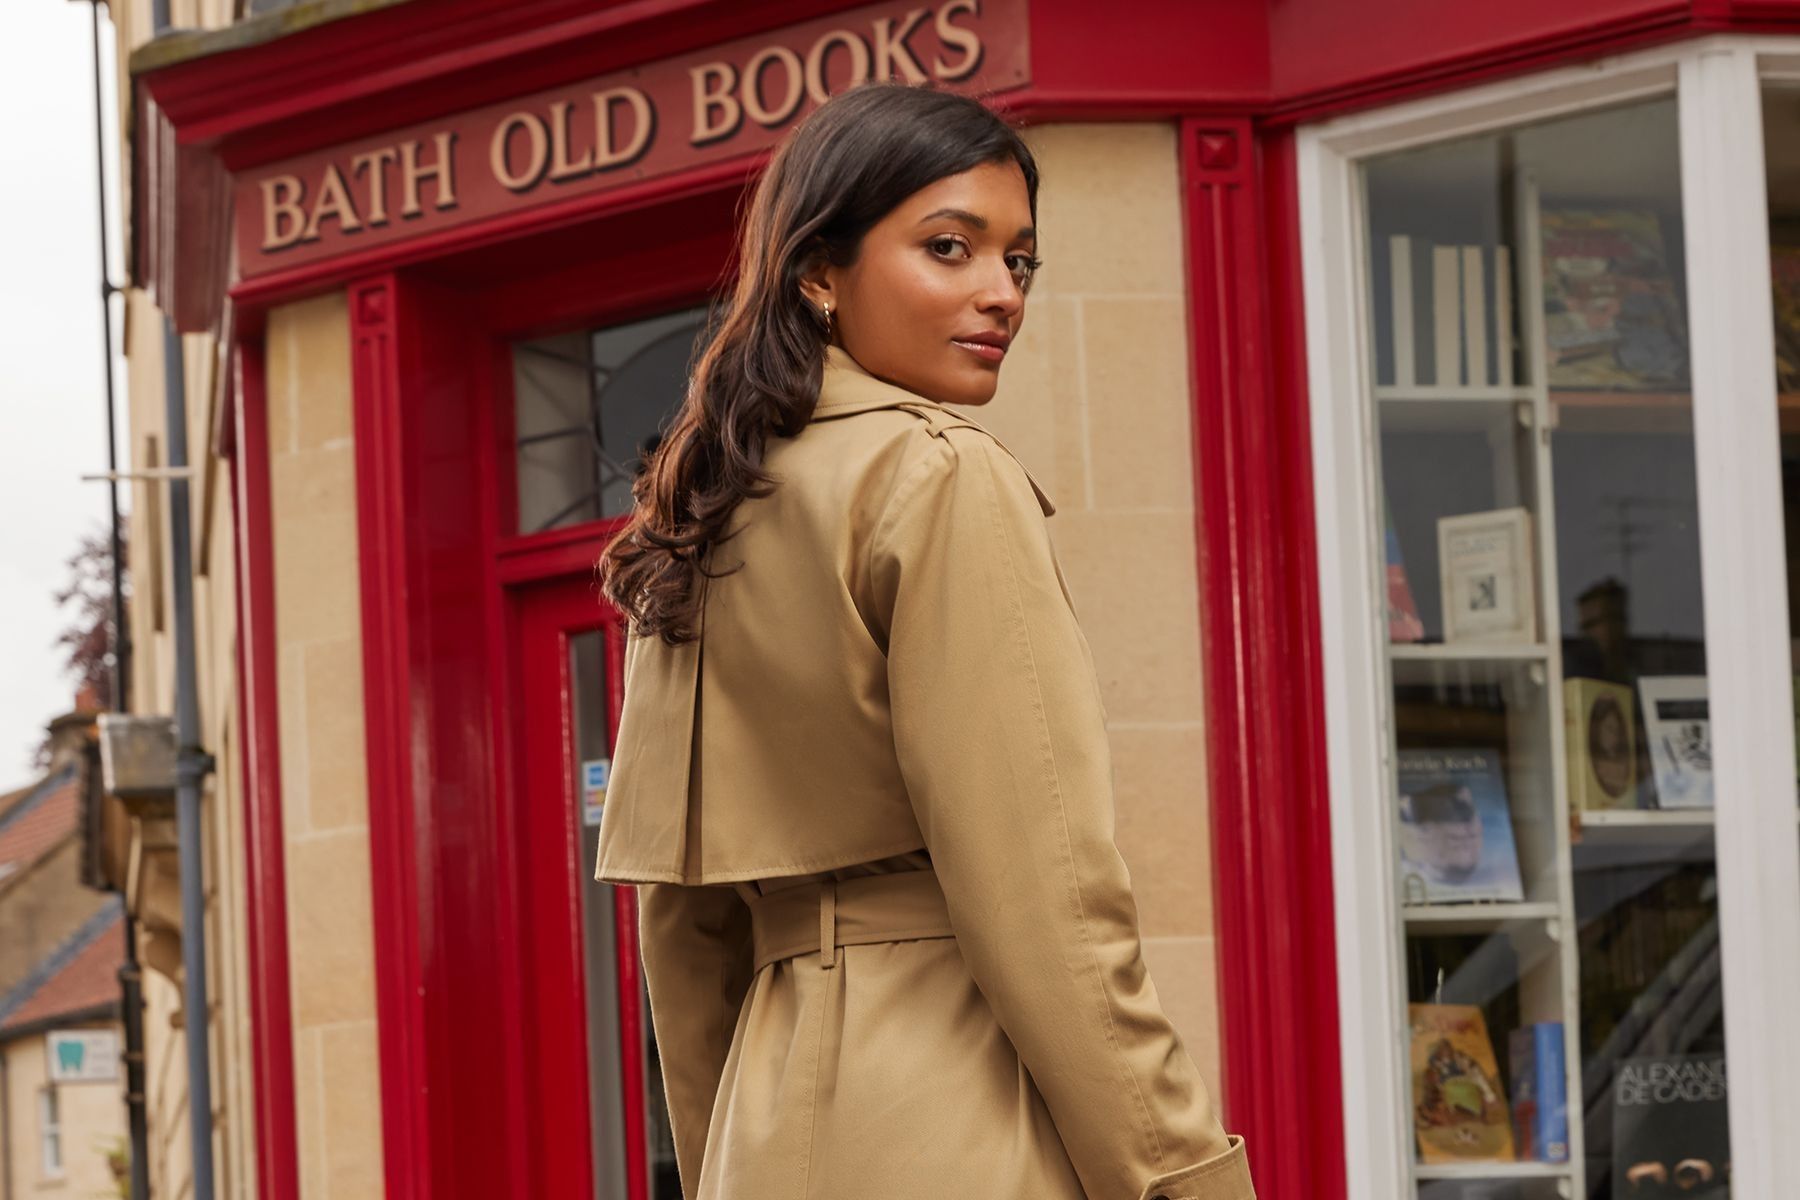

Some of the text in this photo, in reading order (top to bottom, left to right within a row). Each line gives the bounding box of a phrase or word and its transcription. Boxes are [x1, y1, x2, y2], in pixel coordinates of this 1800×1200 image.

[259, 0, 984, 252] BATH OLD BOOKS
